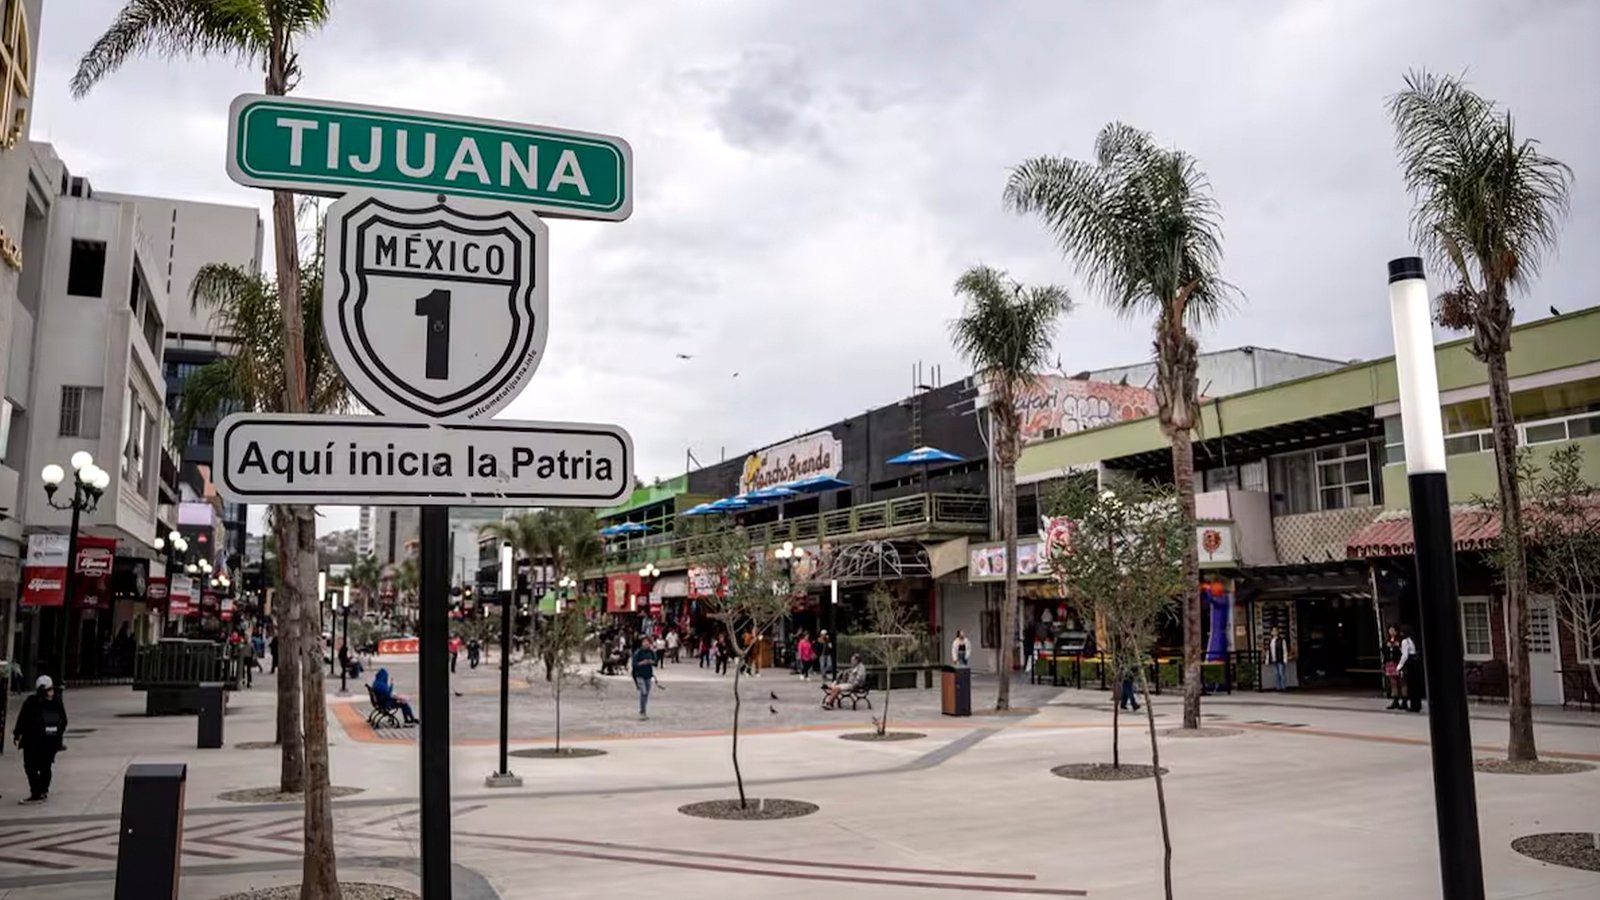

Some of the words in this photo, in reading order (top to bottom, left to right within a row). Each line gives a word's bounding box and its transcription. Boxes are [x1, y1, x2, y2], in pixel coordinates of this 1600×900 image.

[276, 116, 591, 197] TIJUANA
[375, 233, 505, 276] MÉXICO
[414, 288, 452, 381] 1
[467, 349, 537, 420] welcometotijuana.info
[237, 440, 335, 484] Aquí
[349, 442, 453, 478] inicia
[467, 445, 498, 478] la
[512, 446, 613, 481] Patria
[788, 443, 831, 481] Grande
[1391, 543, 1416, 556] CIG
[1456, 539, 1498, 551] IGAR
